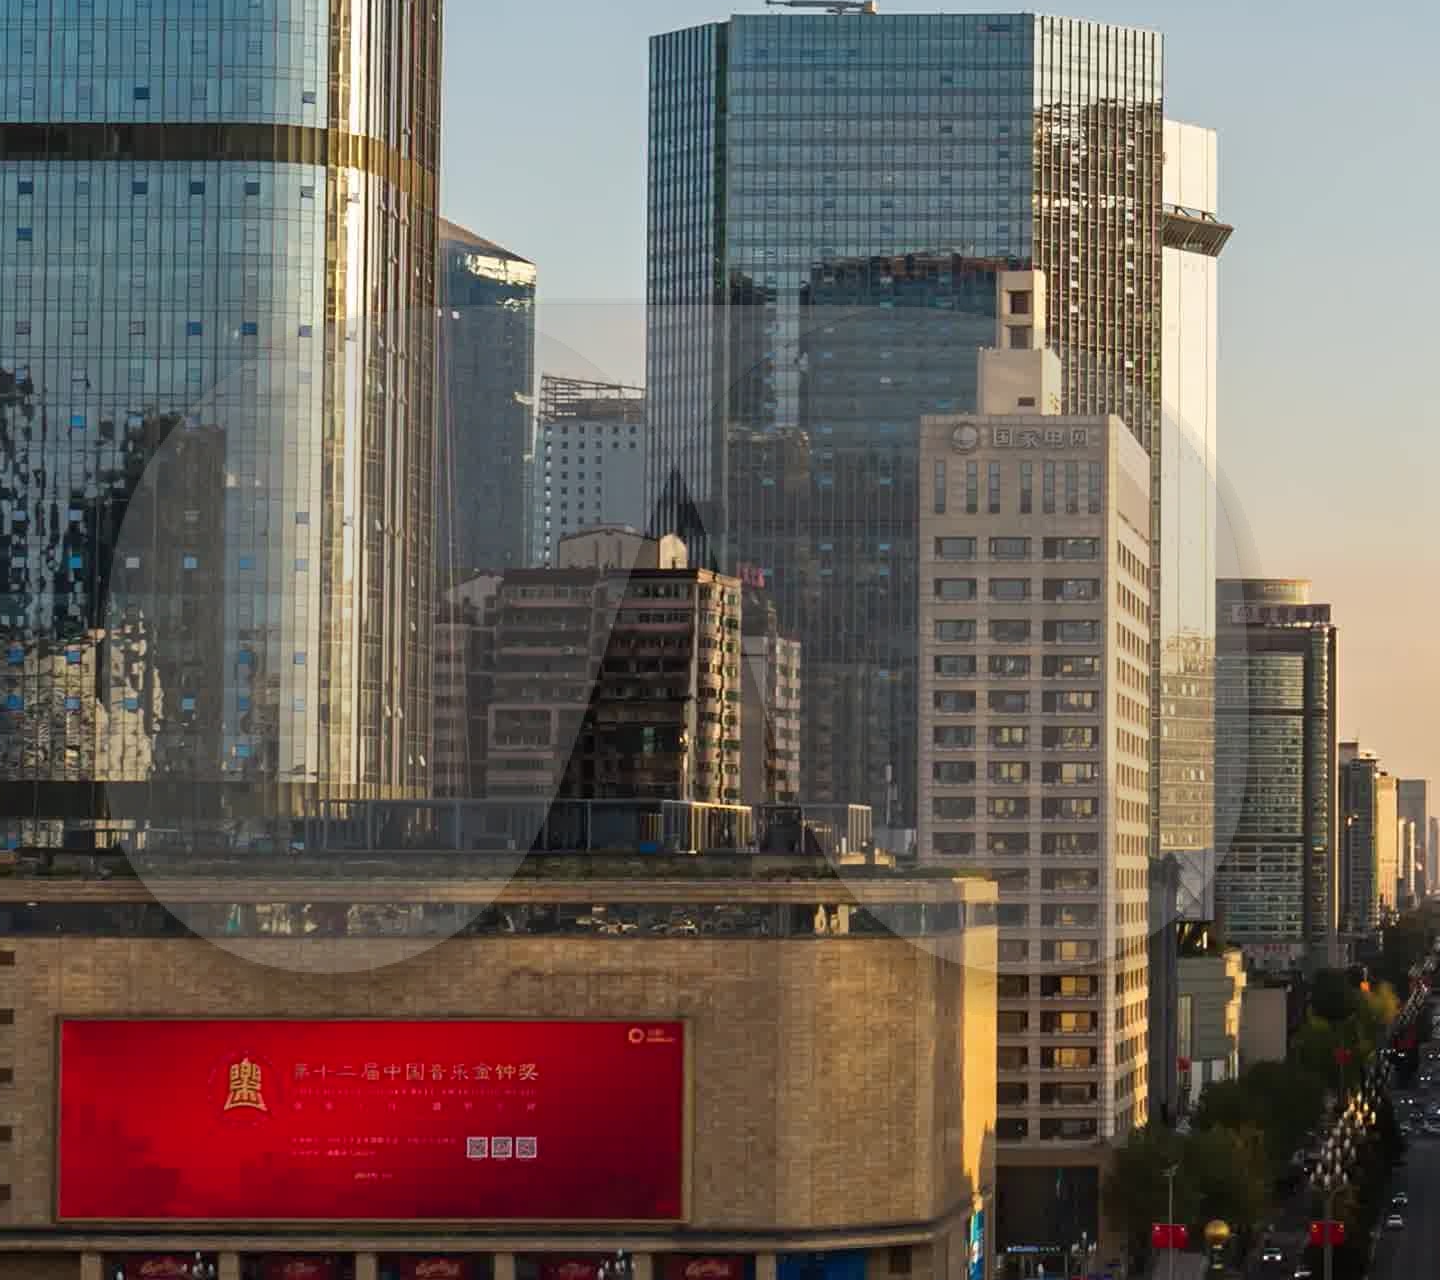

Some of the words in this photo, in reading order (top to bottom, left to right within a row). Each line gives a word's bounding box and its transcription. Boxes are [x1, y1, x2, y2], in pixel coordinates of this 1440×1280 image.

[992, 425, 1090, 449] 国家电网
[292, 1062, 539, 1082] 第十二届中国音乐金钟奖
